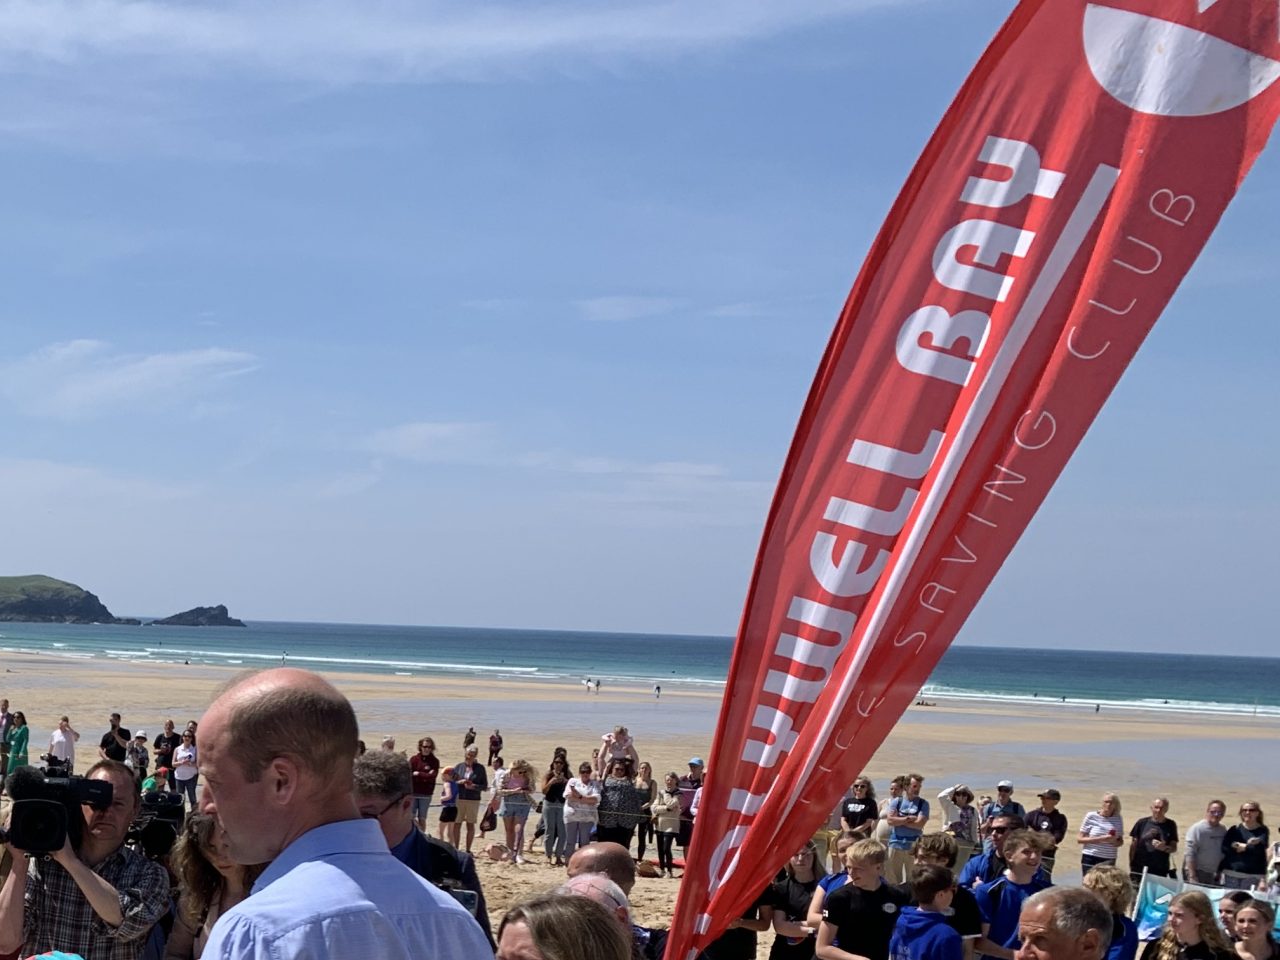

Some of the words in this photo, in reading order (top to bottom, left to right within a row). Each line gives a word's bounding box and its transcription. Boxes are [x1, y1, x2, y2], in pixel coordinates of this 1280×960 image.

[894, 409, 1057, 656] SAVING
[1067, 188, 1196, 360] CLUB
[896, 135, 1066, 387] BAY
